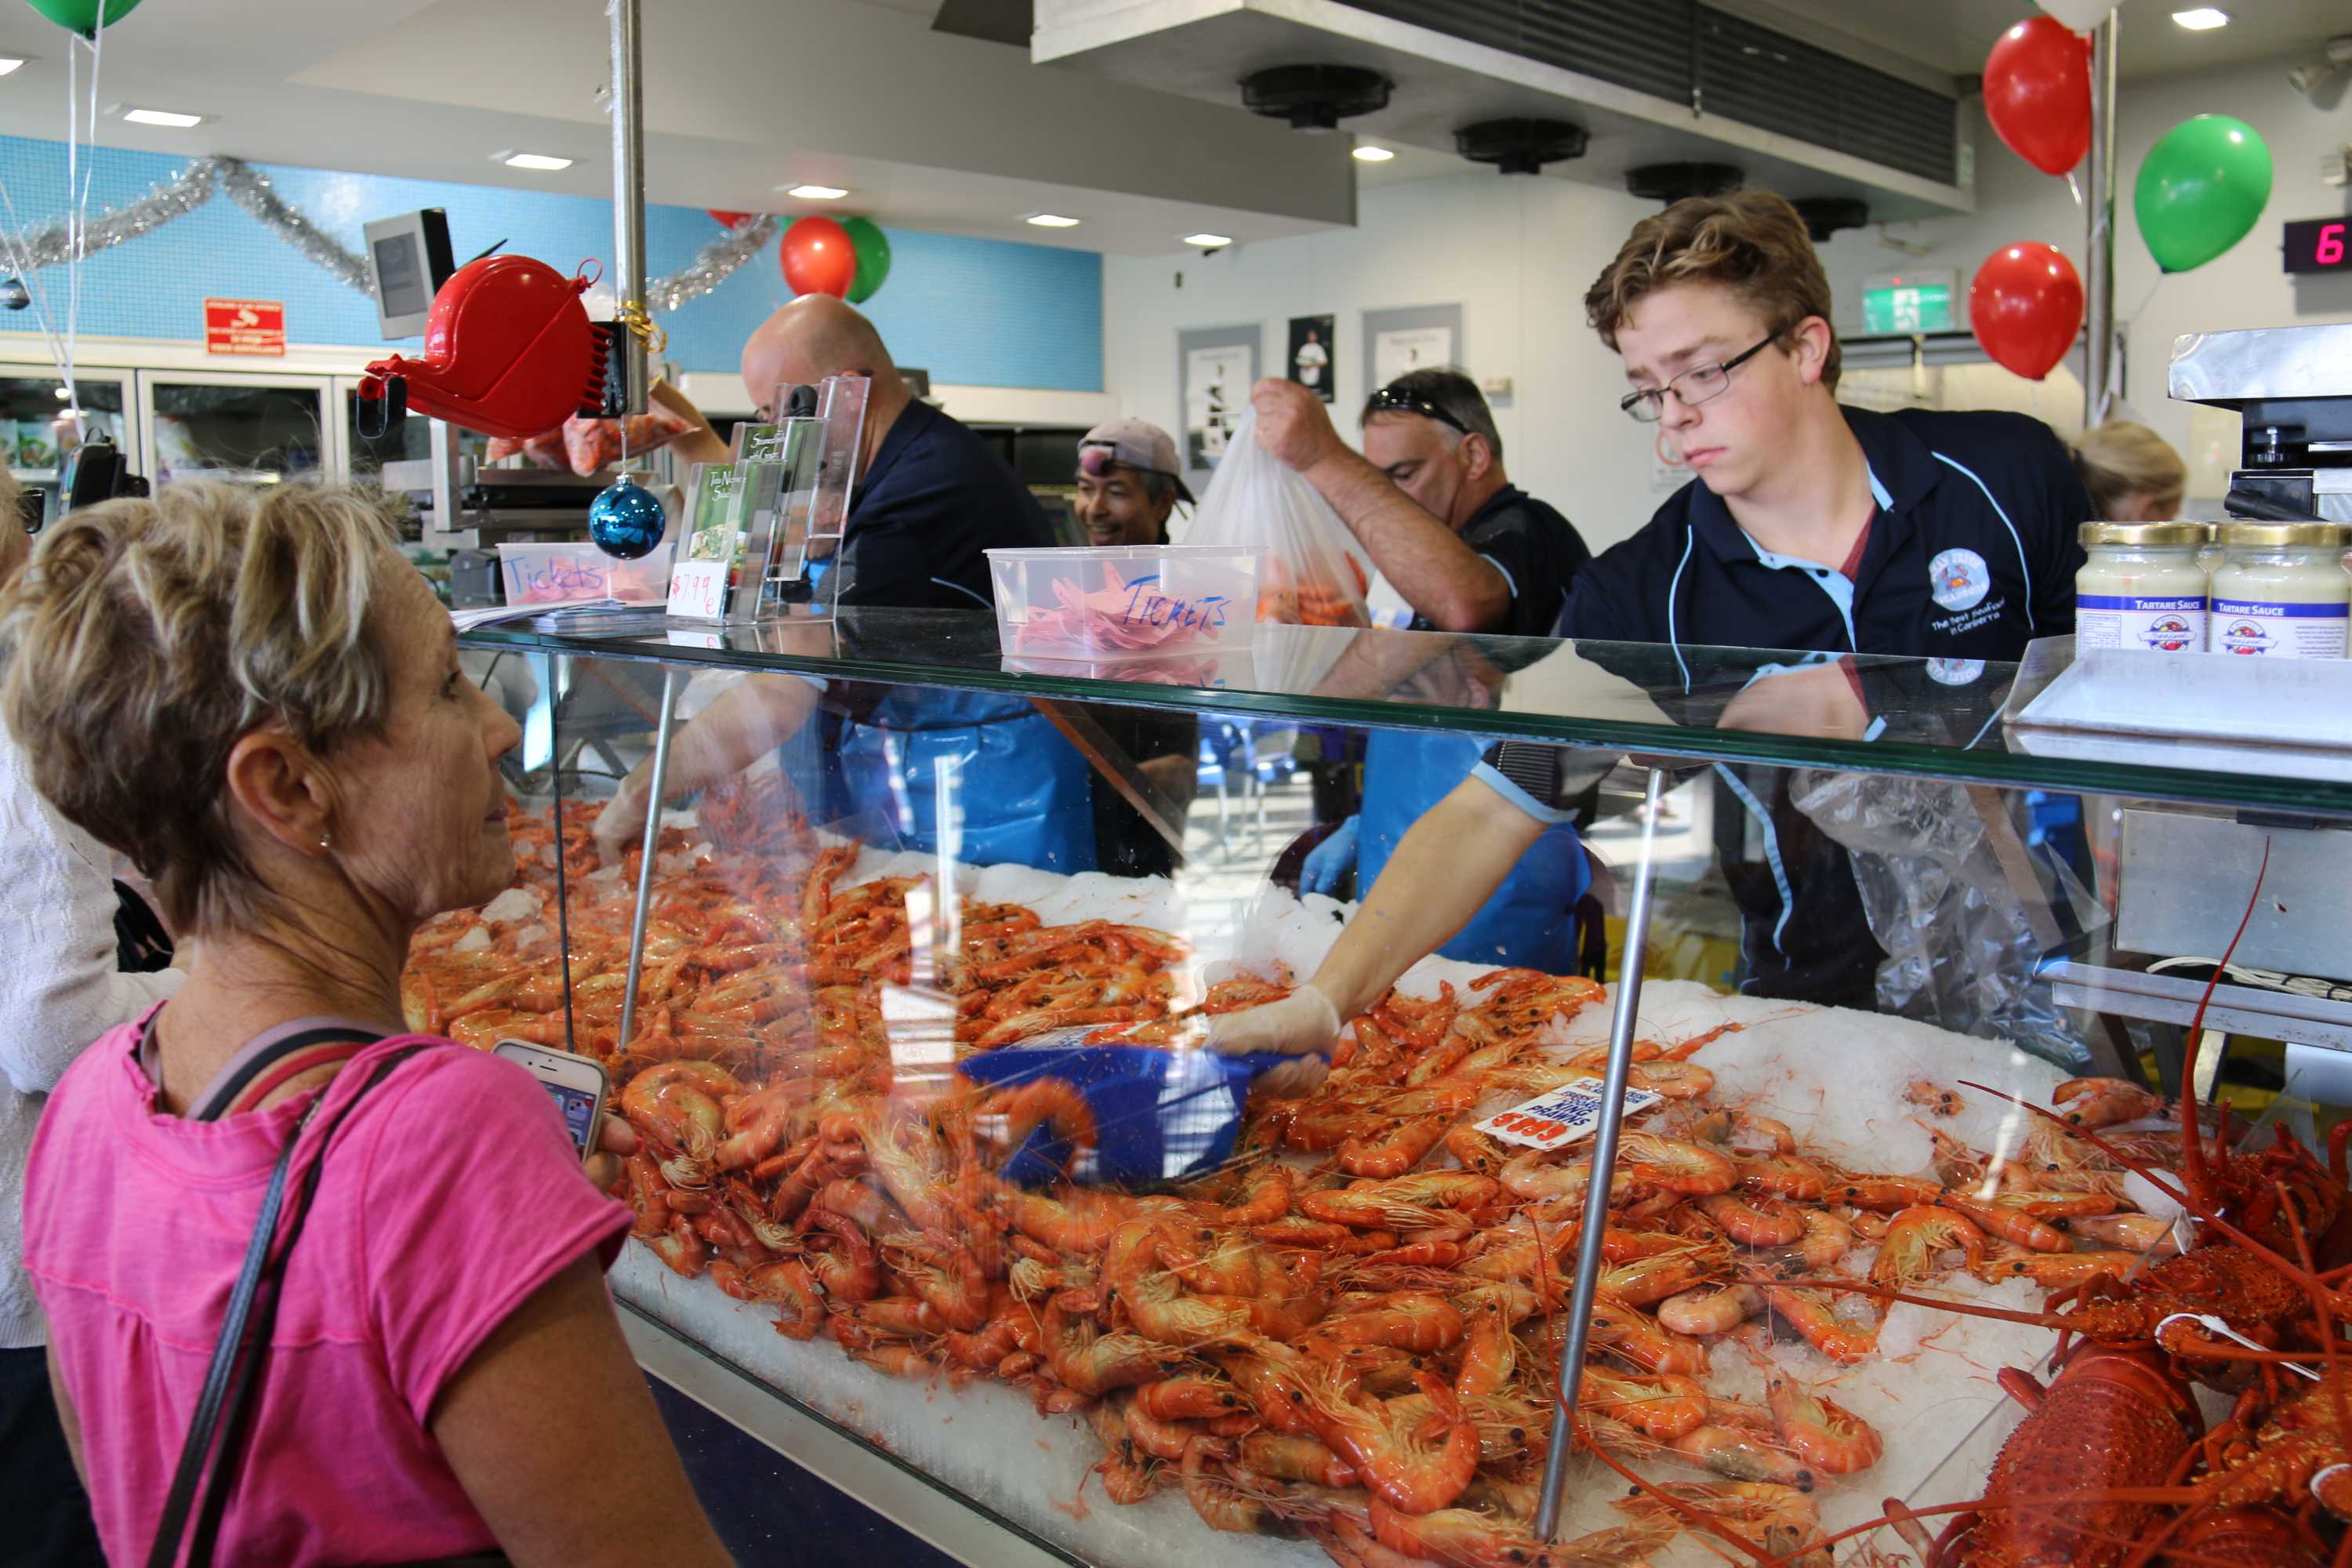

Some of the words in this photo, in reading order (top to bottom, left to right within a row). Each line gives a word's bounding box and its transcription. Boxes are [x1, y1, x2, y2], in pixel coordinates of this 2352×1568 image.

[2316, 223, 2346, 264] 6
[503, 556, 603, 594] Tickets
[2135, 600, 2176, 610] TARTARE
[2177, 600, 2200, 610] SAUCE
[2219, 602, 2249, 615] TARTARE
[2251, 604, 2285, 616] SAUCE
[1931, 619, 1949, 630] The
[1525, 1105, 1591, 1126] PRAWNS
[1550, 1102, 1593, 1116] KING
